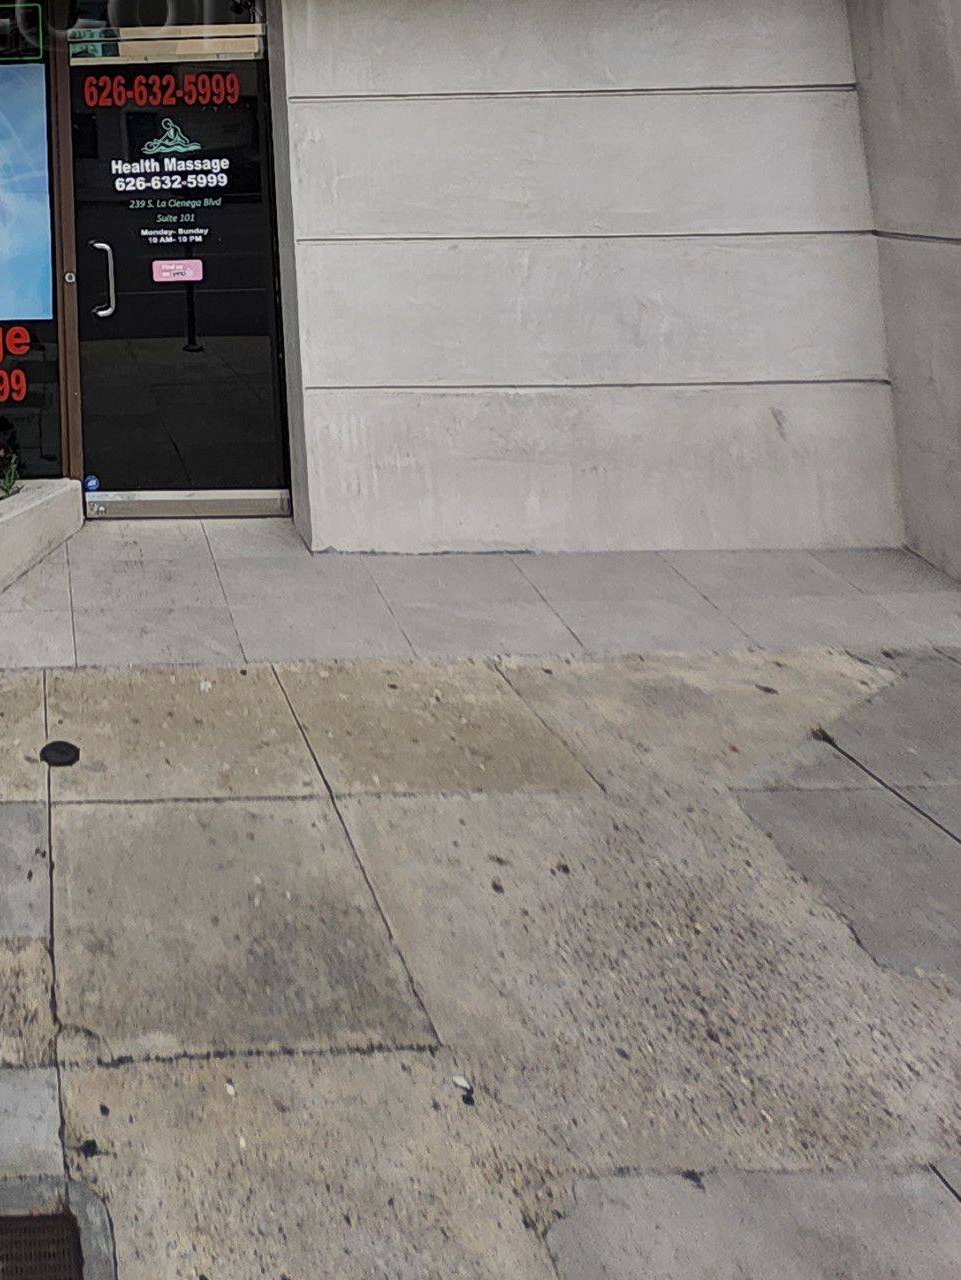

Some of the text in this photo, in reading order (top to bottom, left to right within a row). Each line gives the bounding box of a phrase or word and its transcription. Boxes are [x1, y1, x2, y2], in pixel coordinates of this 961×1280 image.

[84, 72, 241, 107] 626-632-5999
[111, 157, 230, 174] Health Massage
[115, 173, 228, 191] 626-632-5999
[129, 197, 222, 209] 239 S. La Cienega Blvd
[156, 213, 195, 223] Suite 101
[189, 235, 203, 243] PM
